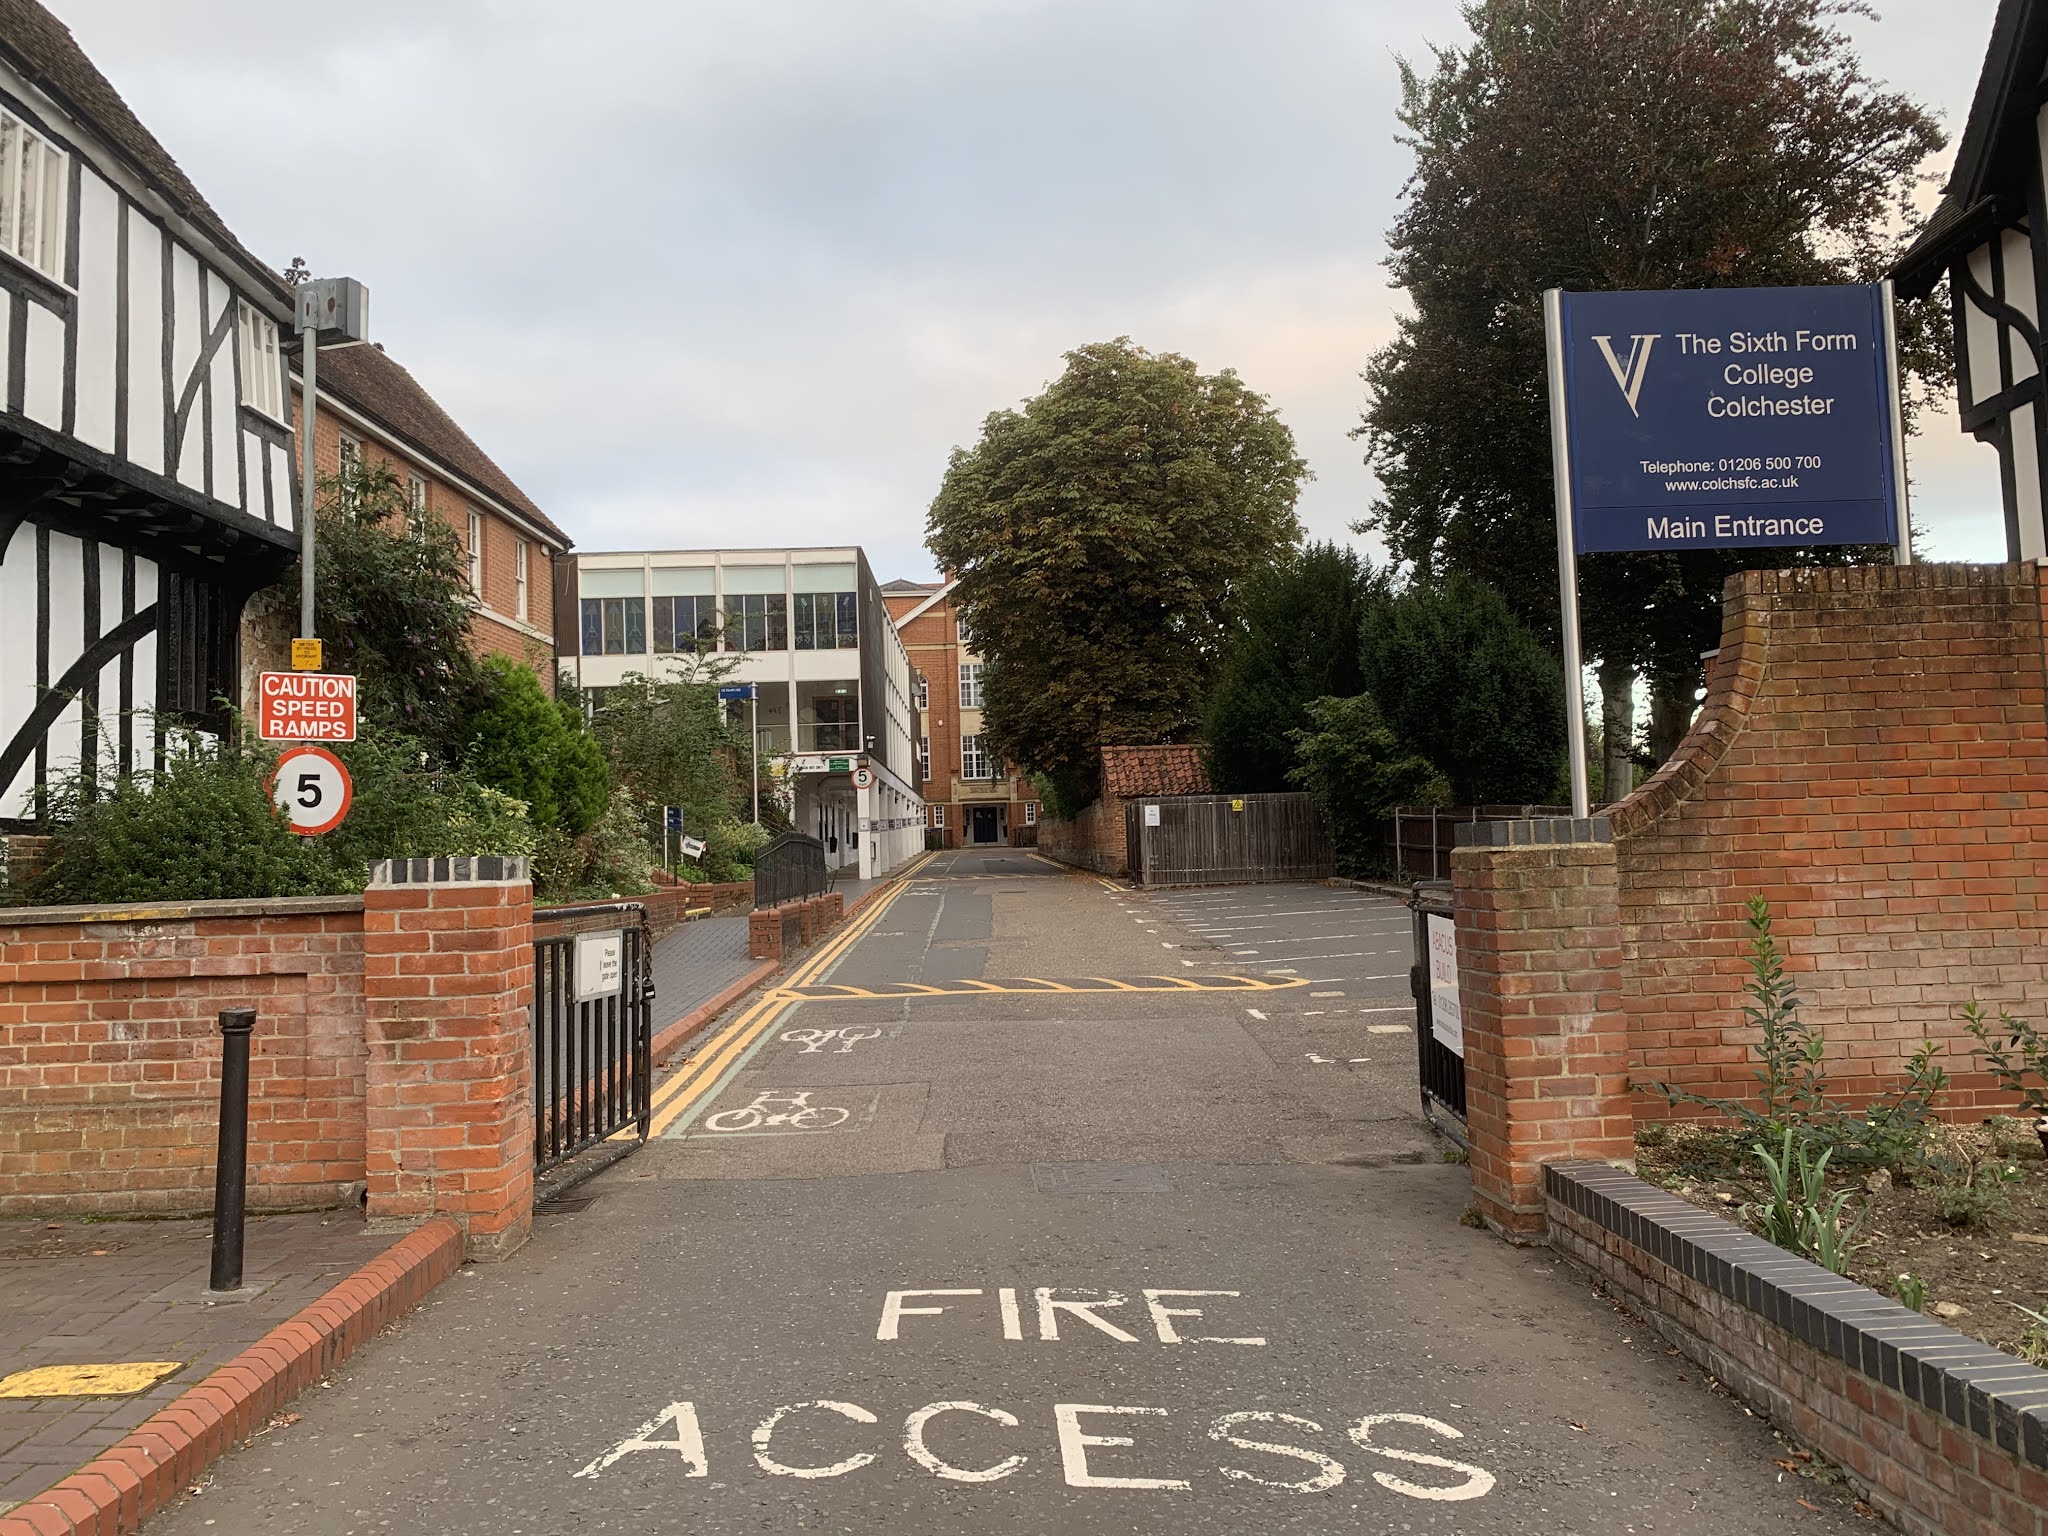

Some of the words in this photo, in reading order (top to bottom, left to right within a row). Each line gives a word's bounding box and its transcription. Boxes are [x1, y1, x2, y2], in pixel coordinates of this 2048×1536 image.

[1675, 333, 1721, 354] The
[1729, 331, 1787, 353] Sixth
[1795, 330, 1857, 352] Form
[1723, 363, 1814, 389] College
[1707, 395, 1834, 418] Colchester
[1640, 459, 1715, 476] Telephone:
[1718, 457, 1762, 472] 01206
[1765, 456, 1792, 470] 500
[1795, 455, 1821, 470] 700
[1665, 474, 1799, 492] www.colchsfc.ac.uk
[1646, 516, 1706, 540] Main
[1714, 514, 1824, 538] Entrance
[264, 675, 353, 698] CAUTION
[272, 699, 345, 718] SPEED
[269, 719, 347, 738] RAMPS
[858, 771, 867, 782] 5
[297, 773, 323, 808] 5
[605, 949, 615, 957] Please
[875, 1287, 1268, 1346] FIRE
[573, 1399, 1497, 1502] ACCESS
